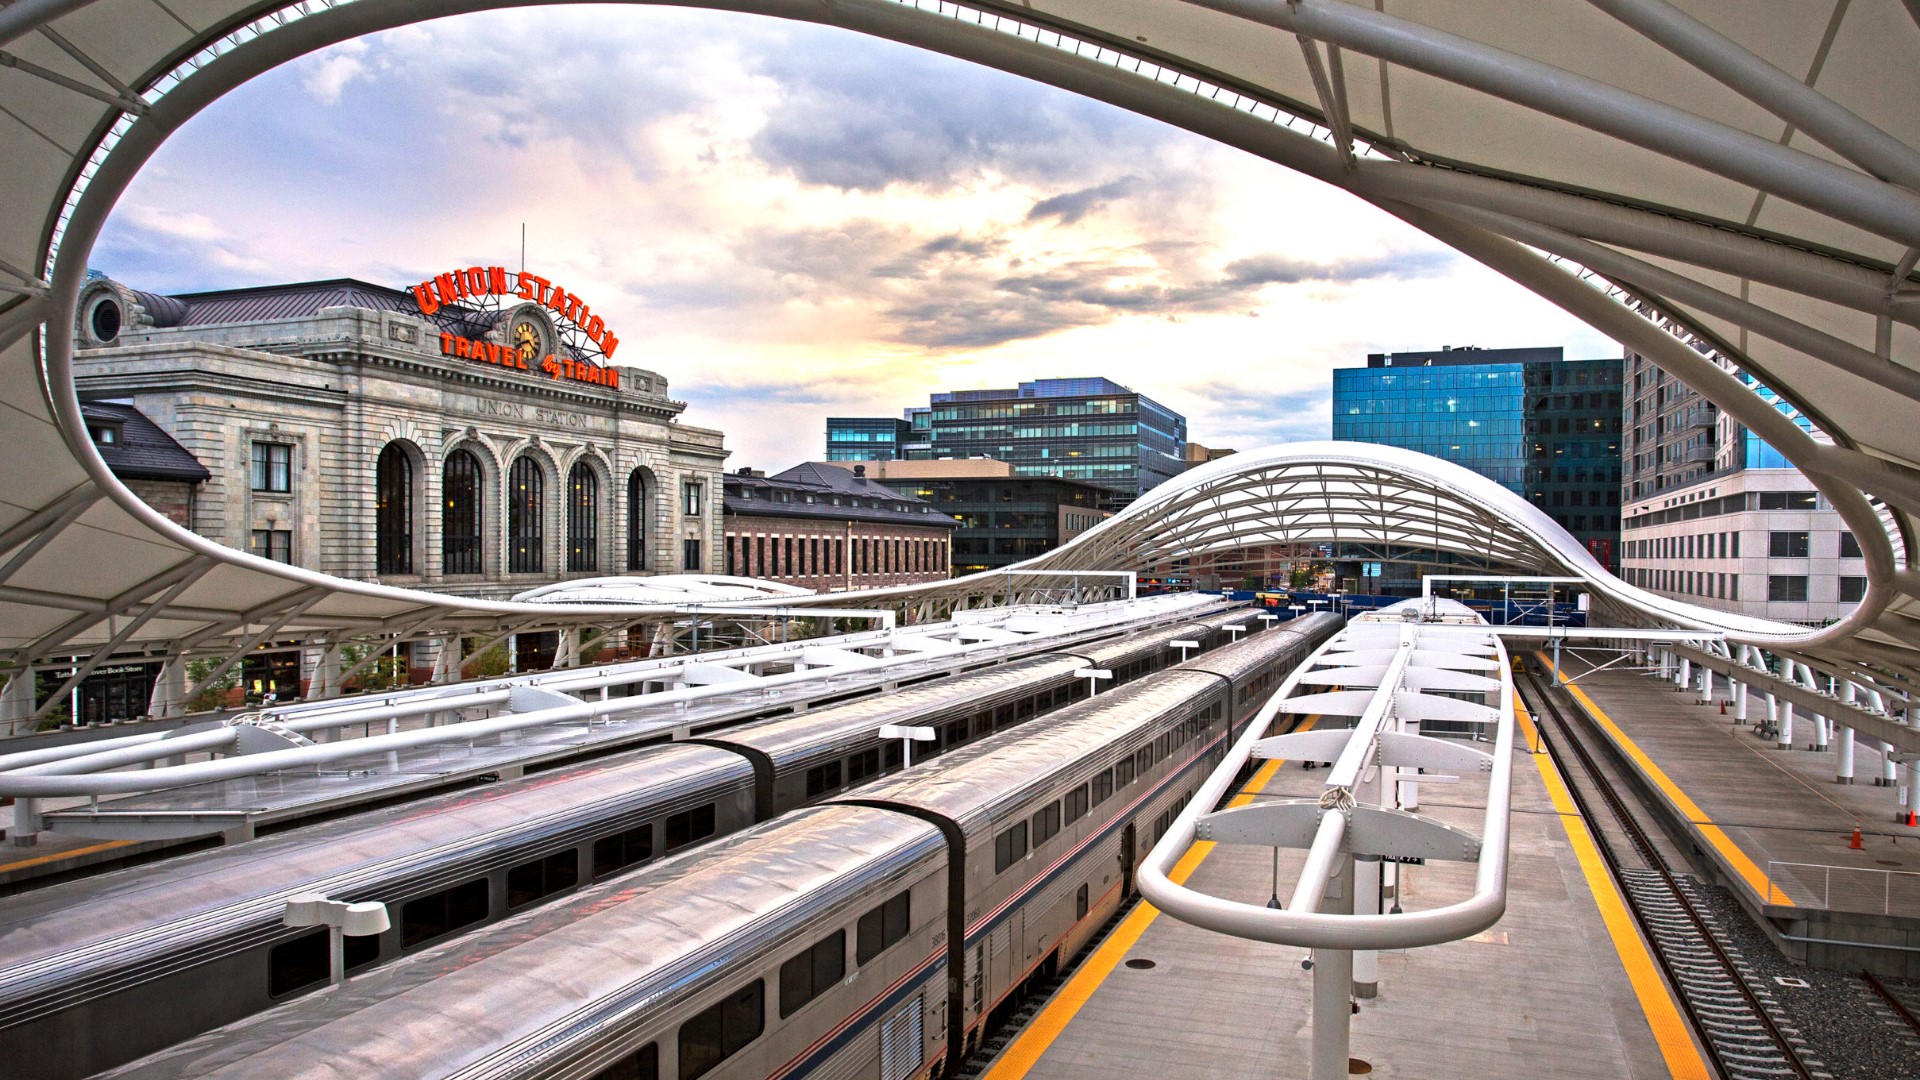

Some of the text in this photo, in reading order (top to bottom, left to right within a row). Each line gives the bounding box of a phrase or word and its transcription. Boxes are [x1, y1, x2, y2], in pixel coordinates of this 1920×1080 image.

[413, 266, 620, 360] UNION STATION
[439, 331, 619, 388] TRAVEL by TRAIN
[476, 399, 587, 428] UNION STATION
